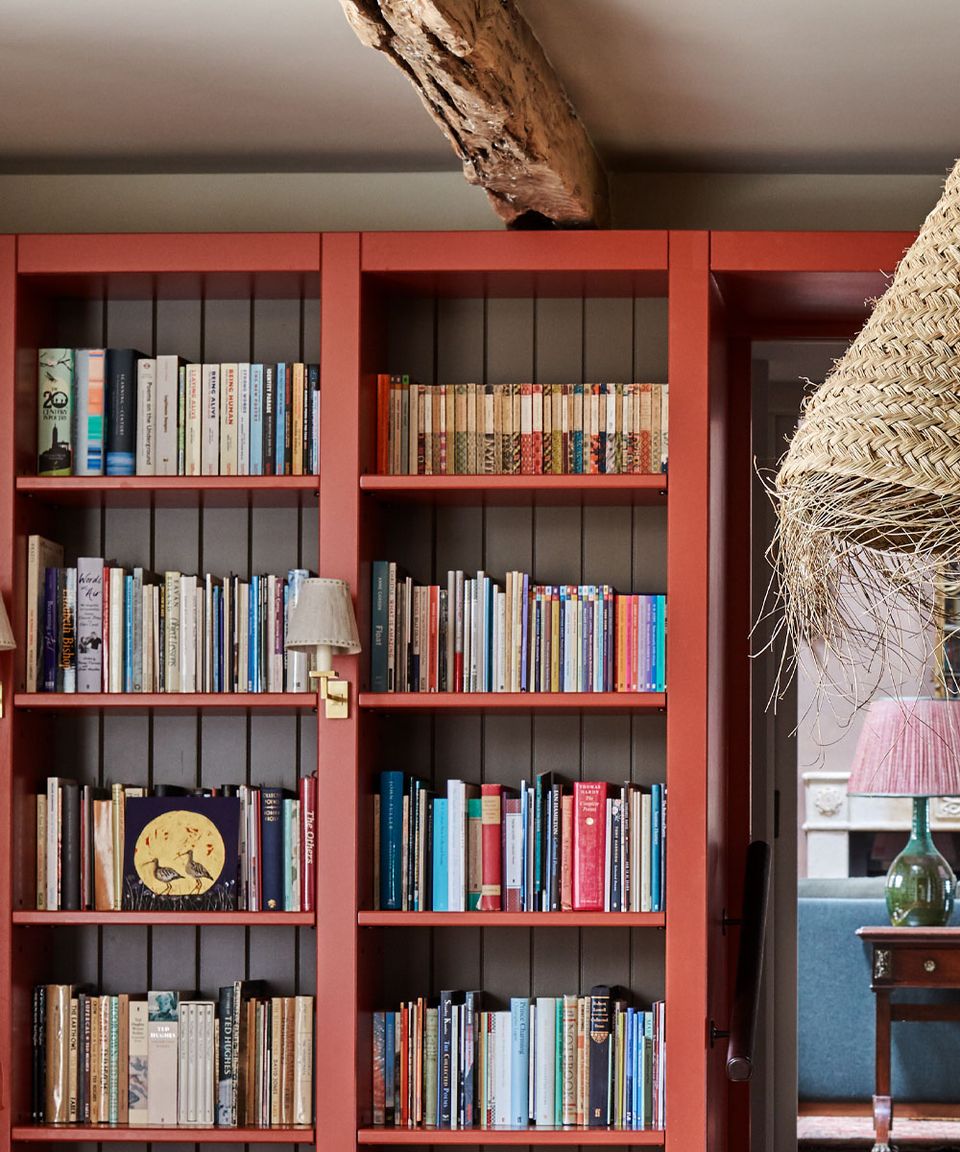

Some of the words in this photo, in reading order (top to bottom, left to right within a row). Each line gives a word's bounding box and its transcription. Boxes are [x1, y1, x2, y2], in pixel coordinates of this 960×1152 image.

[375, 625, 383, 646] Float
[59, 638, 75, 670] Bishop
[306, 810, 314, 829] The
[306, 831, 314, 864] Others
[224, 1016, 232, 1034] TED
[518, 1023, 526, 1054] Charming
[224, 1036, 232, 1074] HUGHES
